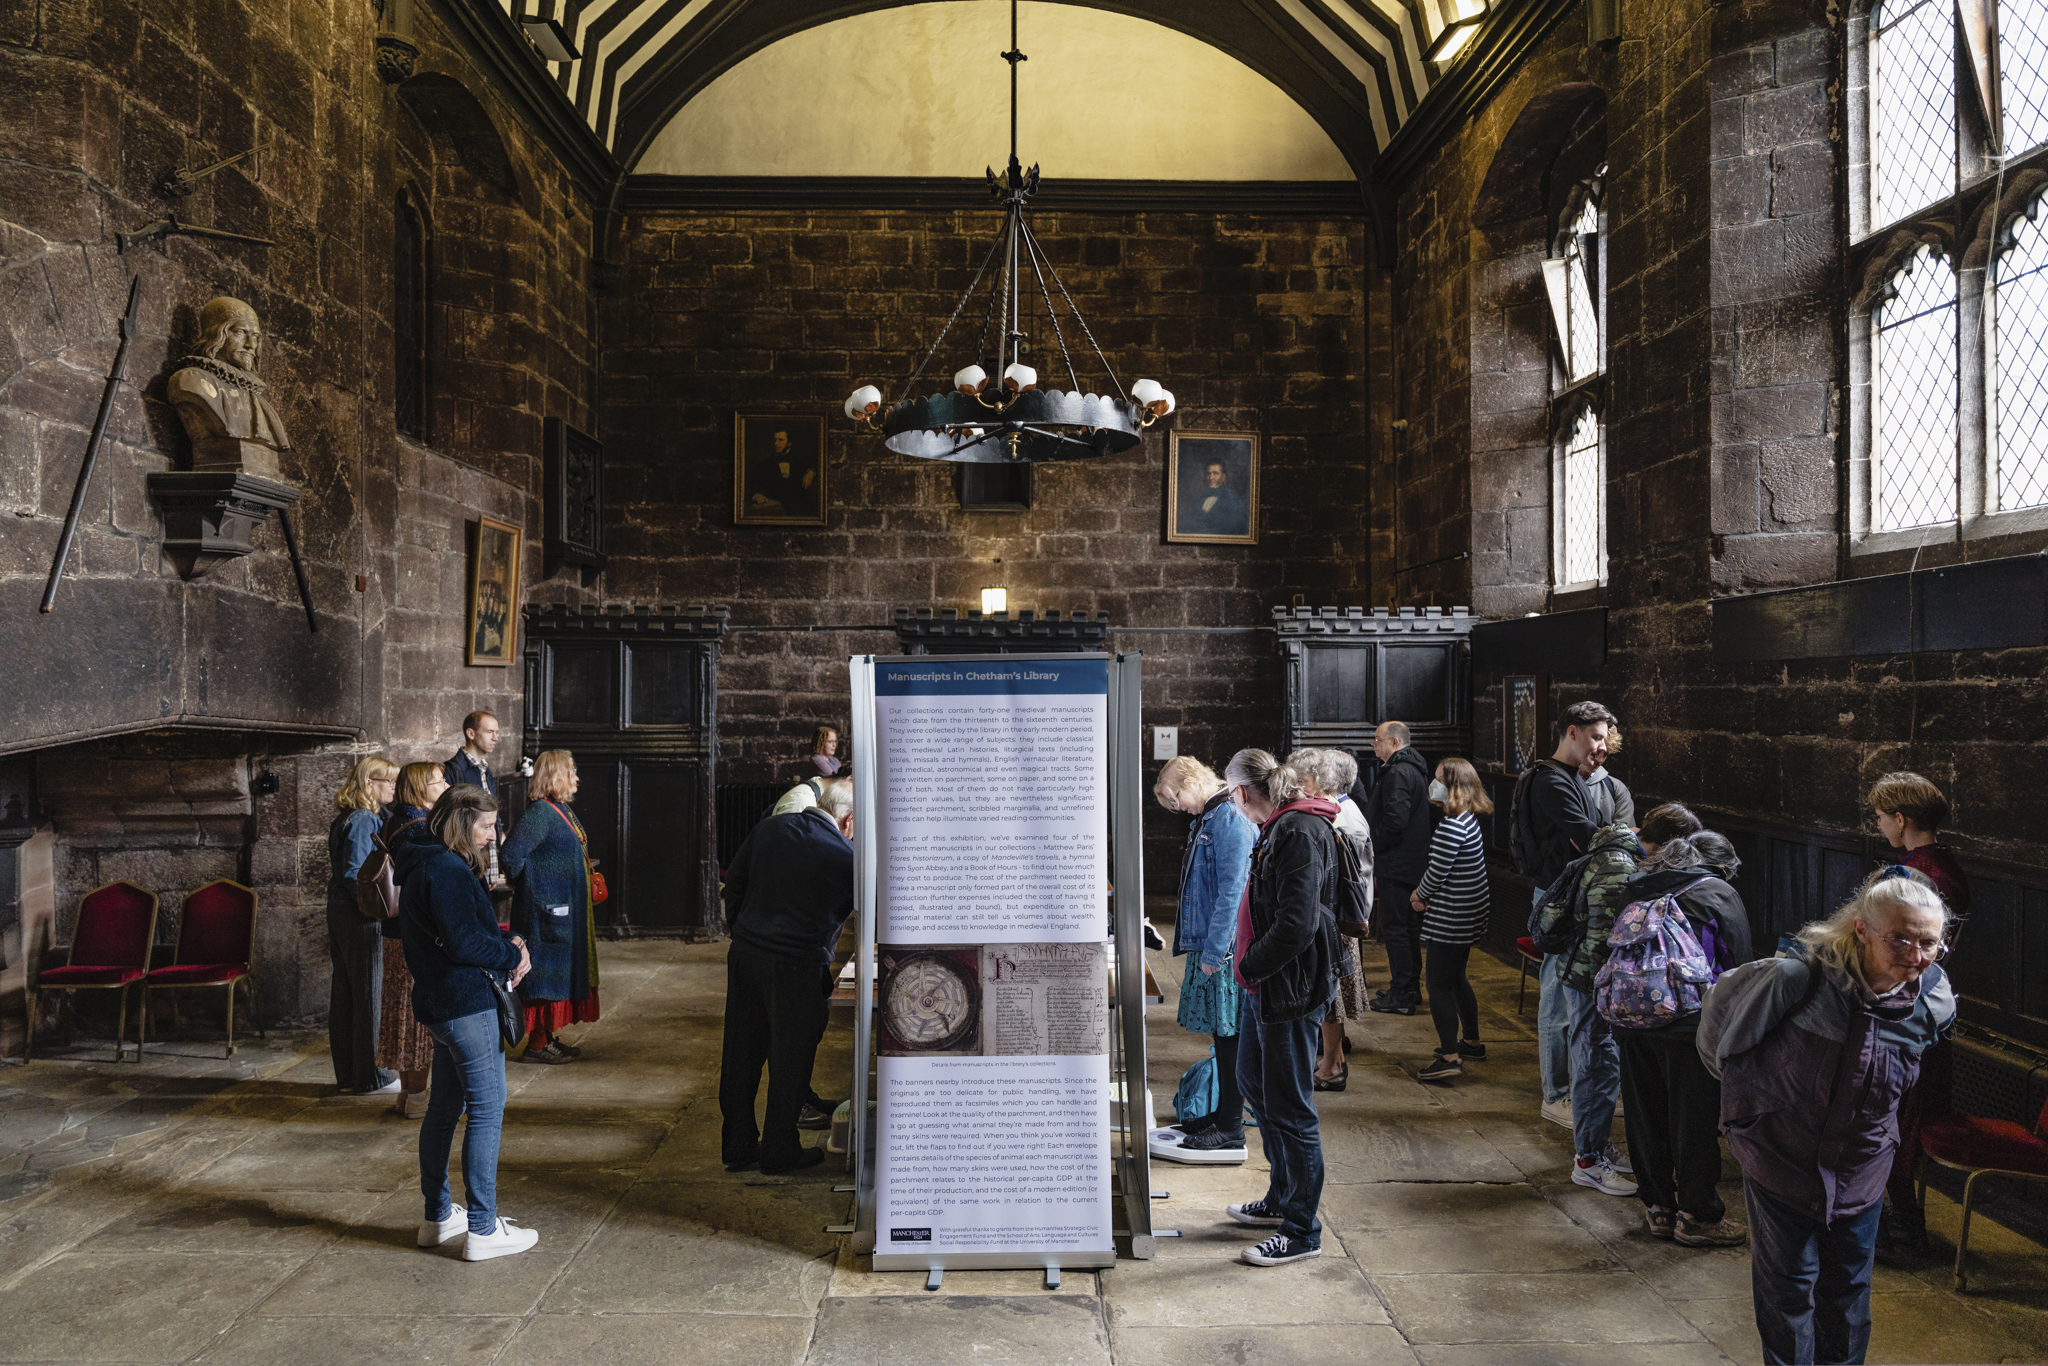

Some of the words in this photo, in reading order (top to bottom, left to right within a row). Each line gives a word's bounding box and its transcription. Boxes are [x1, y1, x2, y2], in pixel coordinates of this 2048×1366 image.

[888, 671, 952, 683] Manuscripts
[953, 671, 964, 681] in
[965, 670, 1022, 680] Chetham's
[1023, 670, 1060, 683] Library
[979, 706, 1011, 715] forty-one
[1051, 706, 1094, 714] manuscripts
[986, 736, 1018, 744] subjects:
[1019, 736, 1035, 744] they
[958, 756, 993, 764] hymnals),
[994, 756, 1020, 764] English
[1020, 765, 1048, 774] magical
[890, 796, 927, 804] production
[975, 795, 991, 804] they
[1058, 794, 1095, 803] significant:
[890, 806, 922, 814] imperfect
[926, 805, 966, 814] parchment,
[1004, 804, 1042, 813] marginalia,
[1069, 853, 1095, 862] hymnal
[890, 904, 916, 912] copied,
[975, 903, 1004, 912] bound),
[1023, 903, 1065, 912] expenditure
[936, 1078, 959, 1087] nearby
[1018, 1077, 1063, 1086] manuscripts.
[890, 1089, 920, 1098] originals
[1002, 1088, 1024, 1097] public
[1029, 1088, 1062, 1097] handling,
[890, 1100, 930, 1109] reproduced
[890, 1176, 929, 1185] parchment
[1018, 1175, 1054, 1184] per-capita
[890, 1198, 929, 1207] equivalent)
[890, 1209, 926, 1218] per-capita
